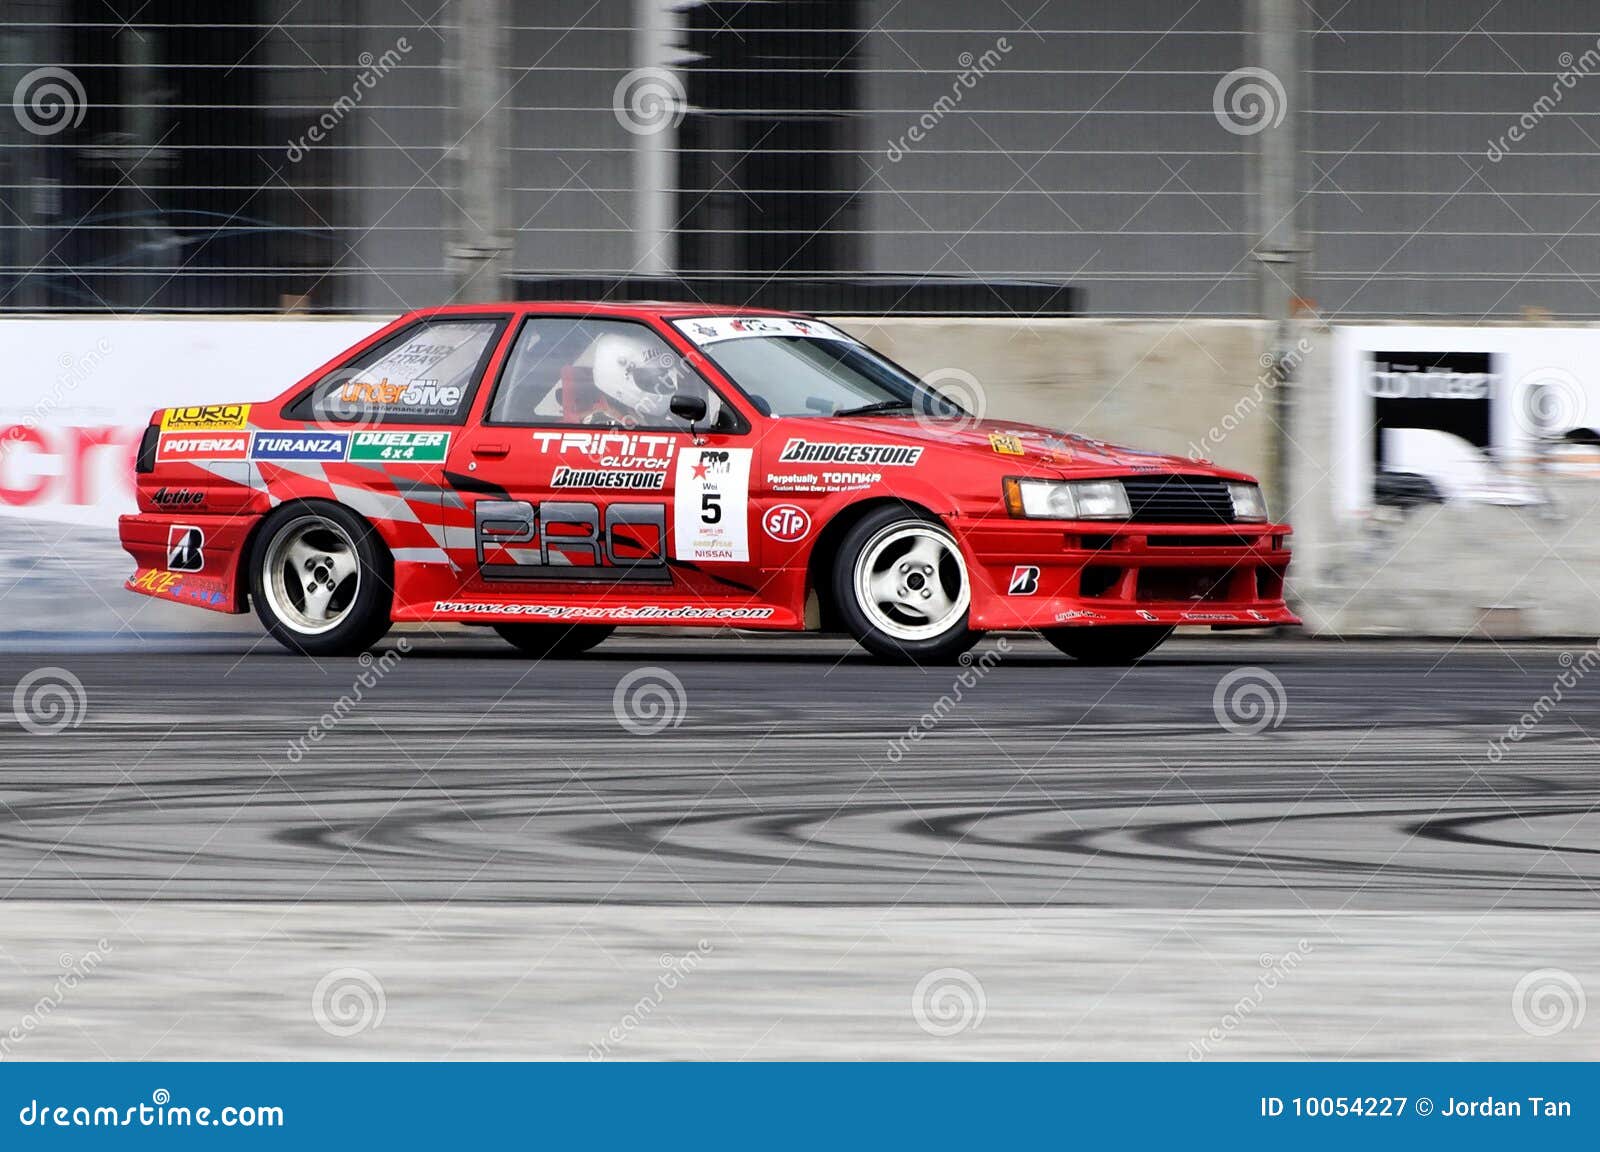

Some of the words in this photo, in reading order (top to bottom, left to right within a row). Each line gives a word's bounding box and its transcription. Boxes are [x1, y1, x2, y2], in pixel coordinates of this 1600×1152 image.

[163, 438, 245, 453] POTENZA
[257, 438, 342, 453] TURANZA
[355, 433, 445, 447] DUELER
[380, 446, 414, 459] 4x4
[780, 439, 923, 465] BRIDGESTONE
[600, 456, 671, 469] CLUTCH
[551, 467, 666, 489] BRIDGESTONE
[767, 473, 818, 485] Perpetually
[152, 487, 205, 505] Active
[701, 493, 722, 525] 5
[769, 508, 804, 536] STP
[474, 500, 668, 568] PRO
[695, 550, 733, 559] NISSAN
[433, 600, 774, 620] www.crazypartsfinder.com
